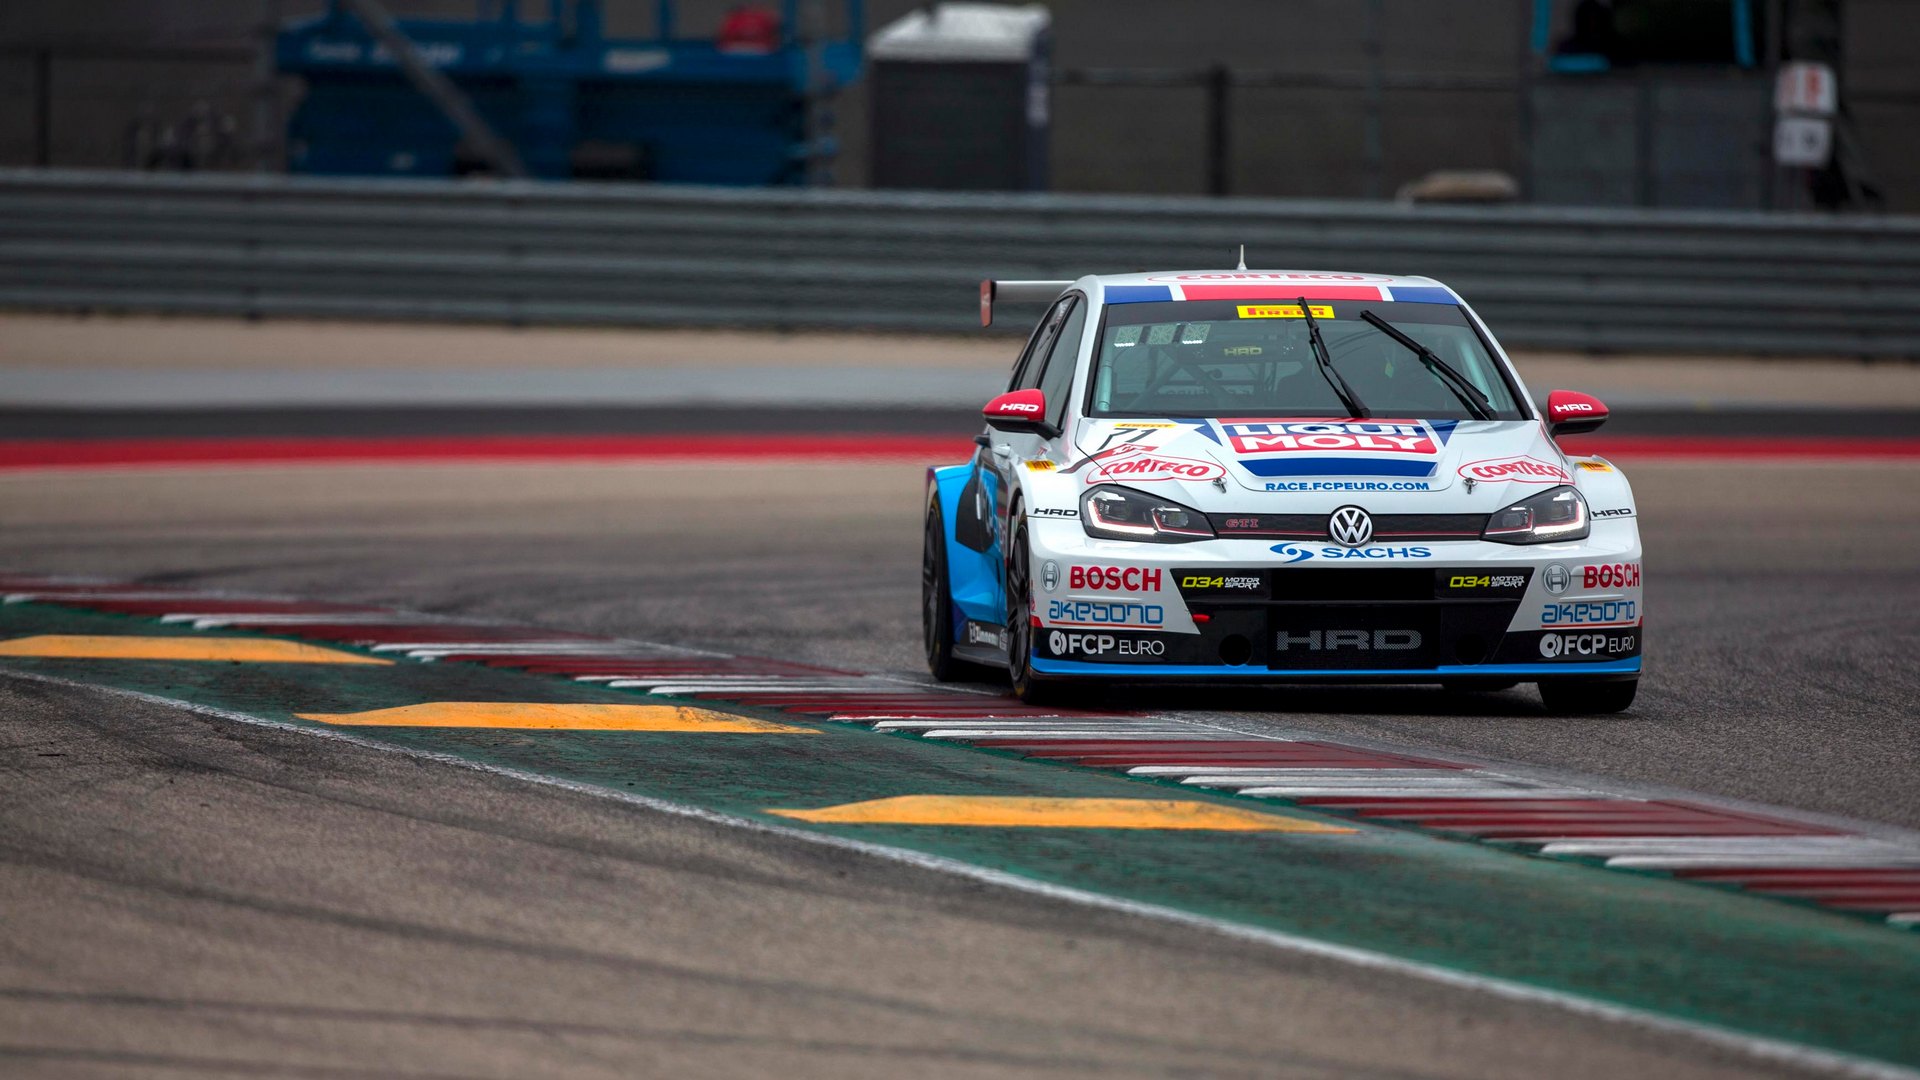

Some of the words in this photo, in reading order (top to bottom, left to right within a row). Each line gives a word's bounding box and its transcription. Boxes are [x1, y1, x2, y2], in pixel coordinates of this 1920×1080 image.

[1224, 347, 1263, 356] HRD
[1000, 403, 1040, 413] HRD
[1554, 403, 1593, 413] HRD
[1232, 423, 1418, 435] LIQUI
[1096, 428, 1158, 451] 71
[1240, 434, 1428, 451] MOLY
[1099, 458, 1211, 477] CORTECO
[1471, 460, 1570, 479] CORTECO
[1265, 482, 1430, 491] RACE.FCPEURO.COM
[1033, 507, 1079, 517] HRD
[1592, 508, 1633, 518] HRD
[1225, 518, 1260, 528] GTI
[1321, 547, 1432, 559] SACHS
[1070, 566, 1162, 592] BOSCH
[1182, 576, 1224, 588] 034
[1449, 576, 1491, 588] 034
[1583, 563, 1640, 589] BOSCH
[1224, 582, 1259, 590] SPORT
[1490, 580, 1525, 589] SPORT
[1068, 634, 1115, 654] FCP
[1118, 639, 1165, 656] EURO
[1276, 629, 1422, 651] HRD
[1564, 634, 1607, 655] FCP
[1608, 635, 1635, 653] EURO
